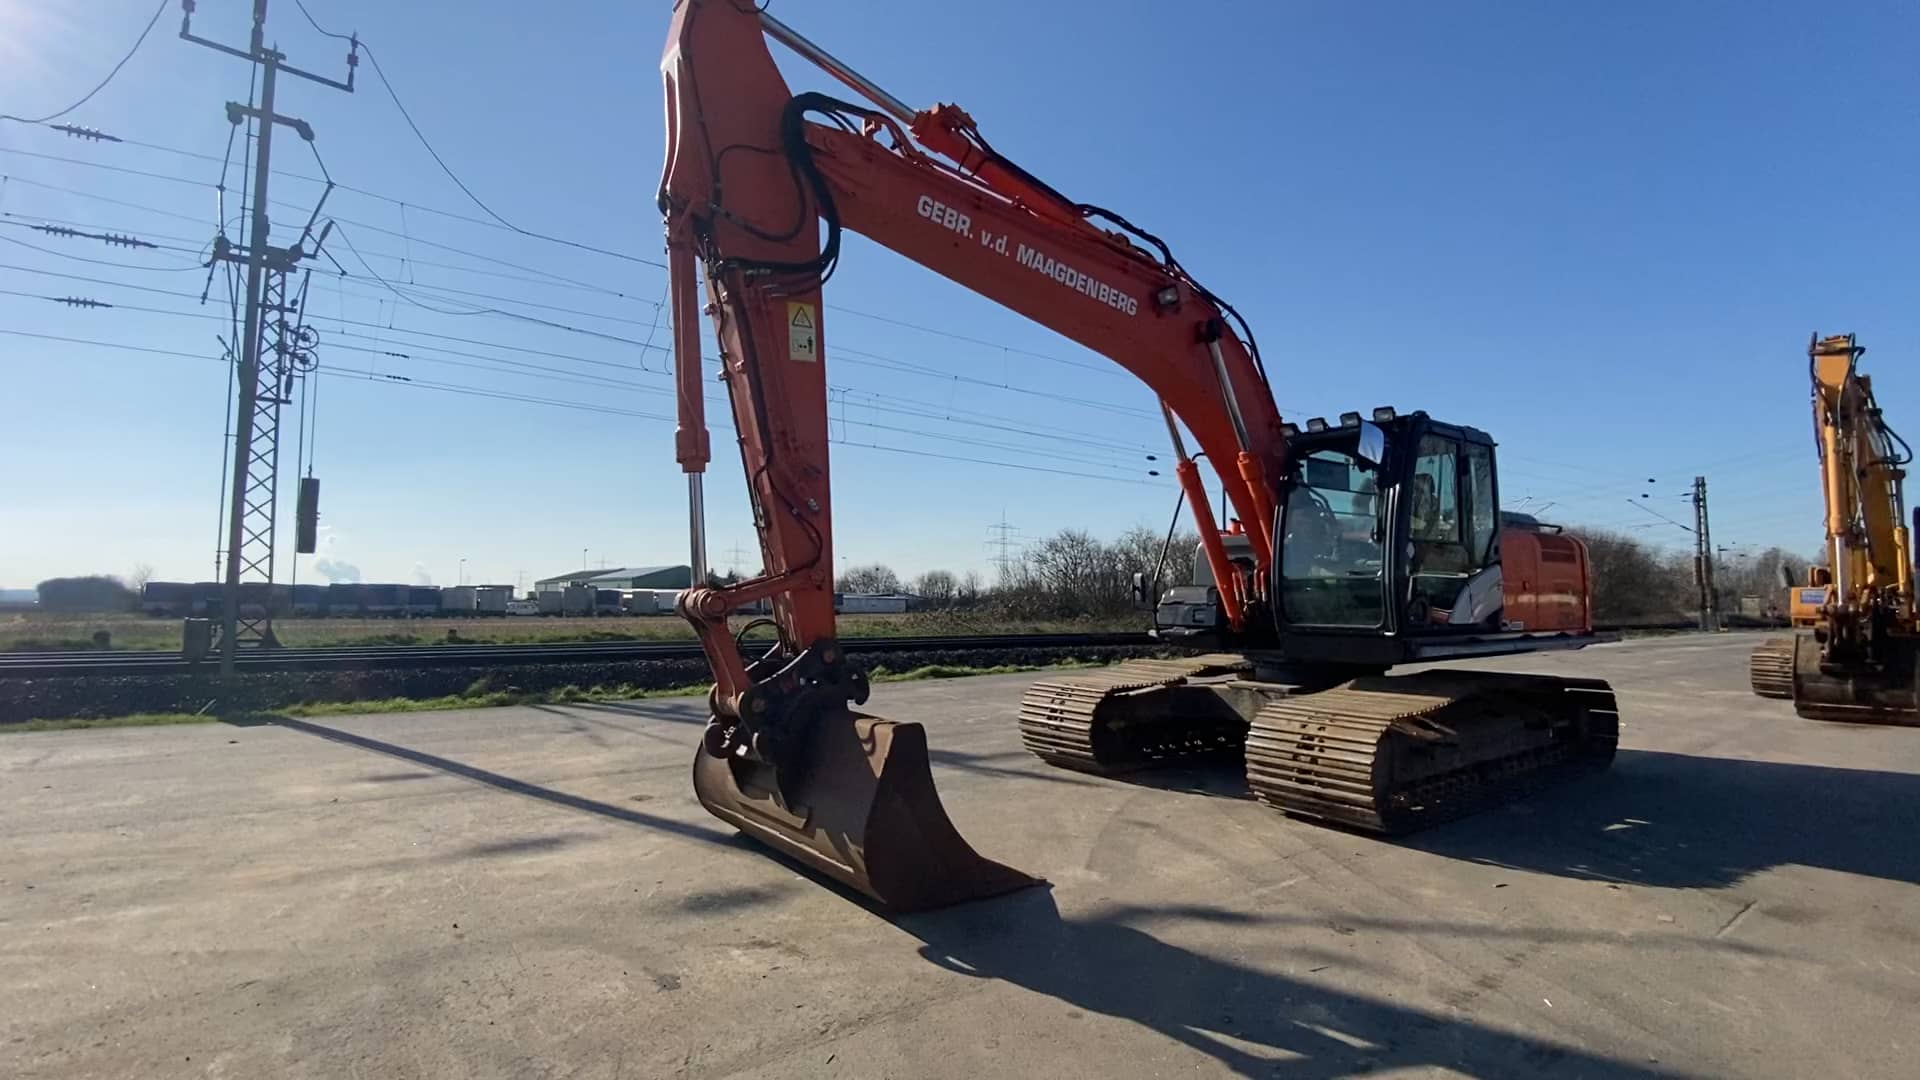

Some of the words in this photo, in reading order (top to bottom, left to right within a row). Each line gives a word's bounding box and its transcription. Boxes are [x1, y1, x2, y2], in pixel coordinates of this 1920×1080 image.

[917, 195, 974, 239] GEBR.
[980, 230, 1010, 257] v.d.
[1016, 244, 1138, 316] MAAGDENBERG
